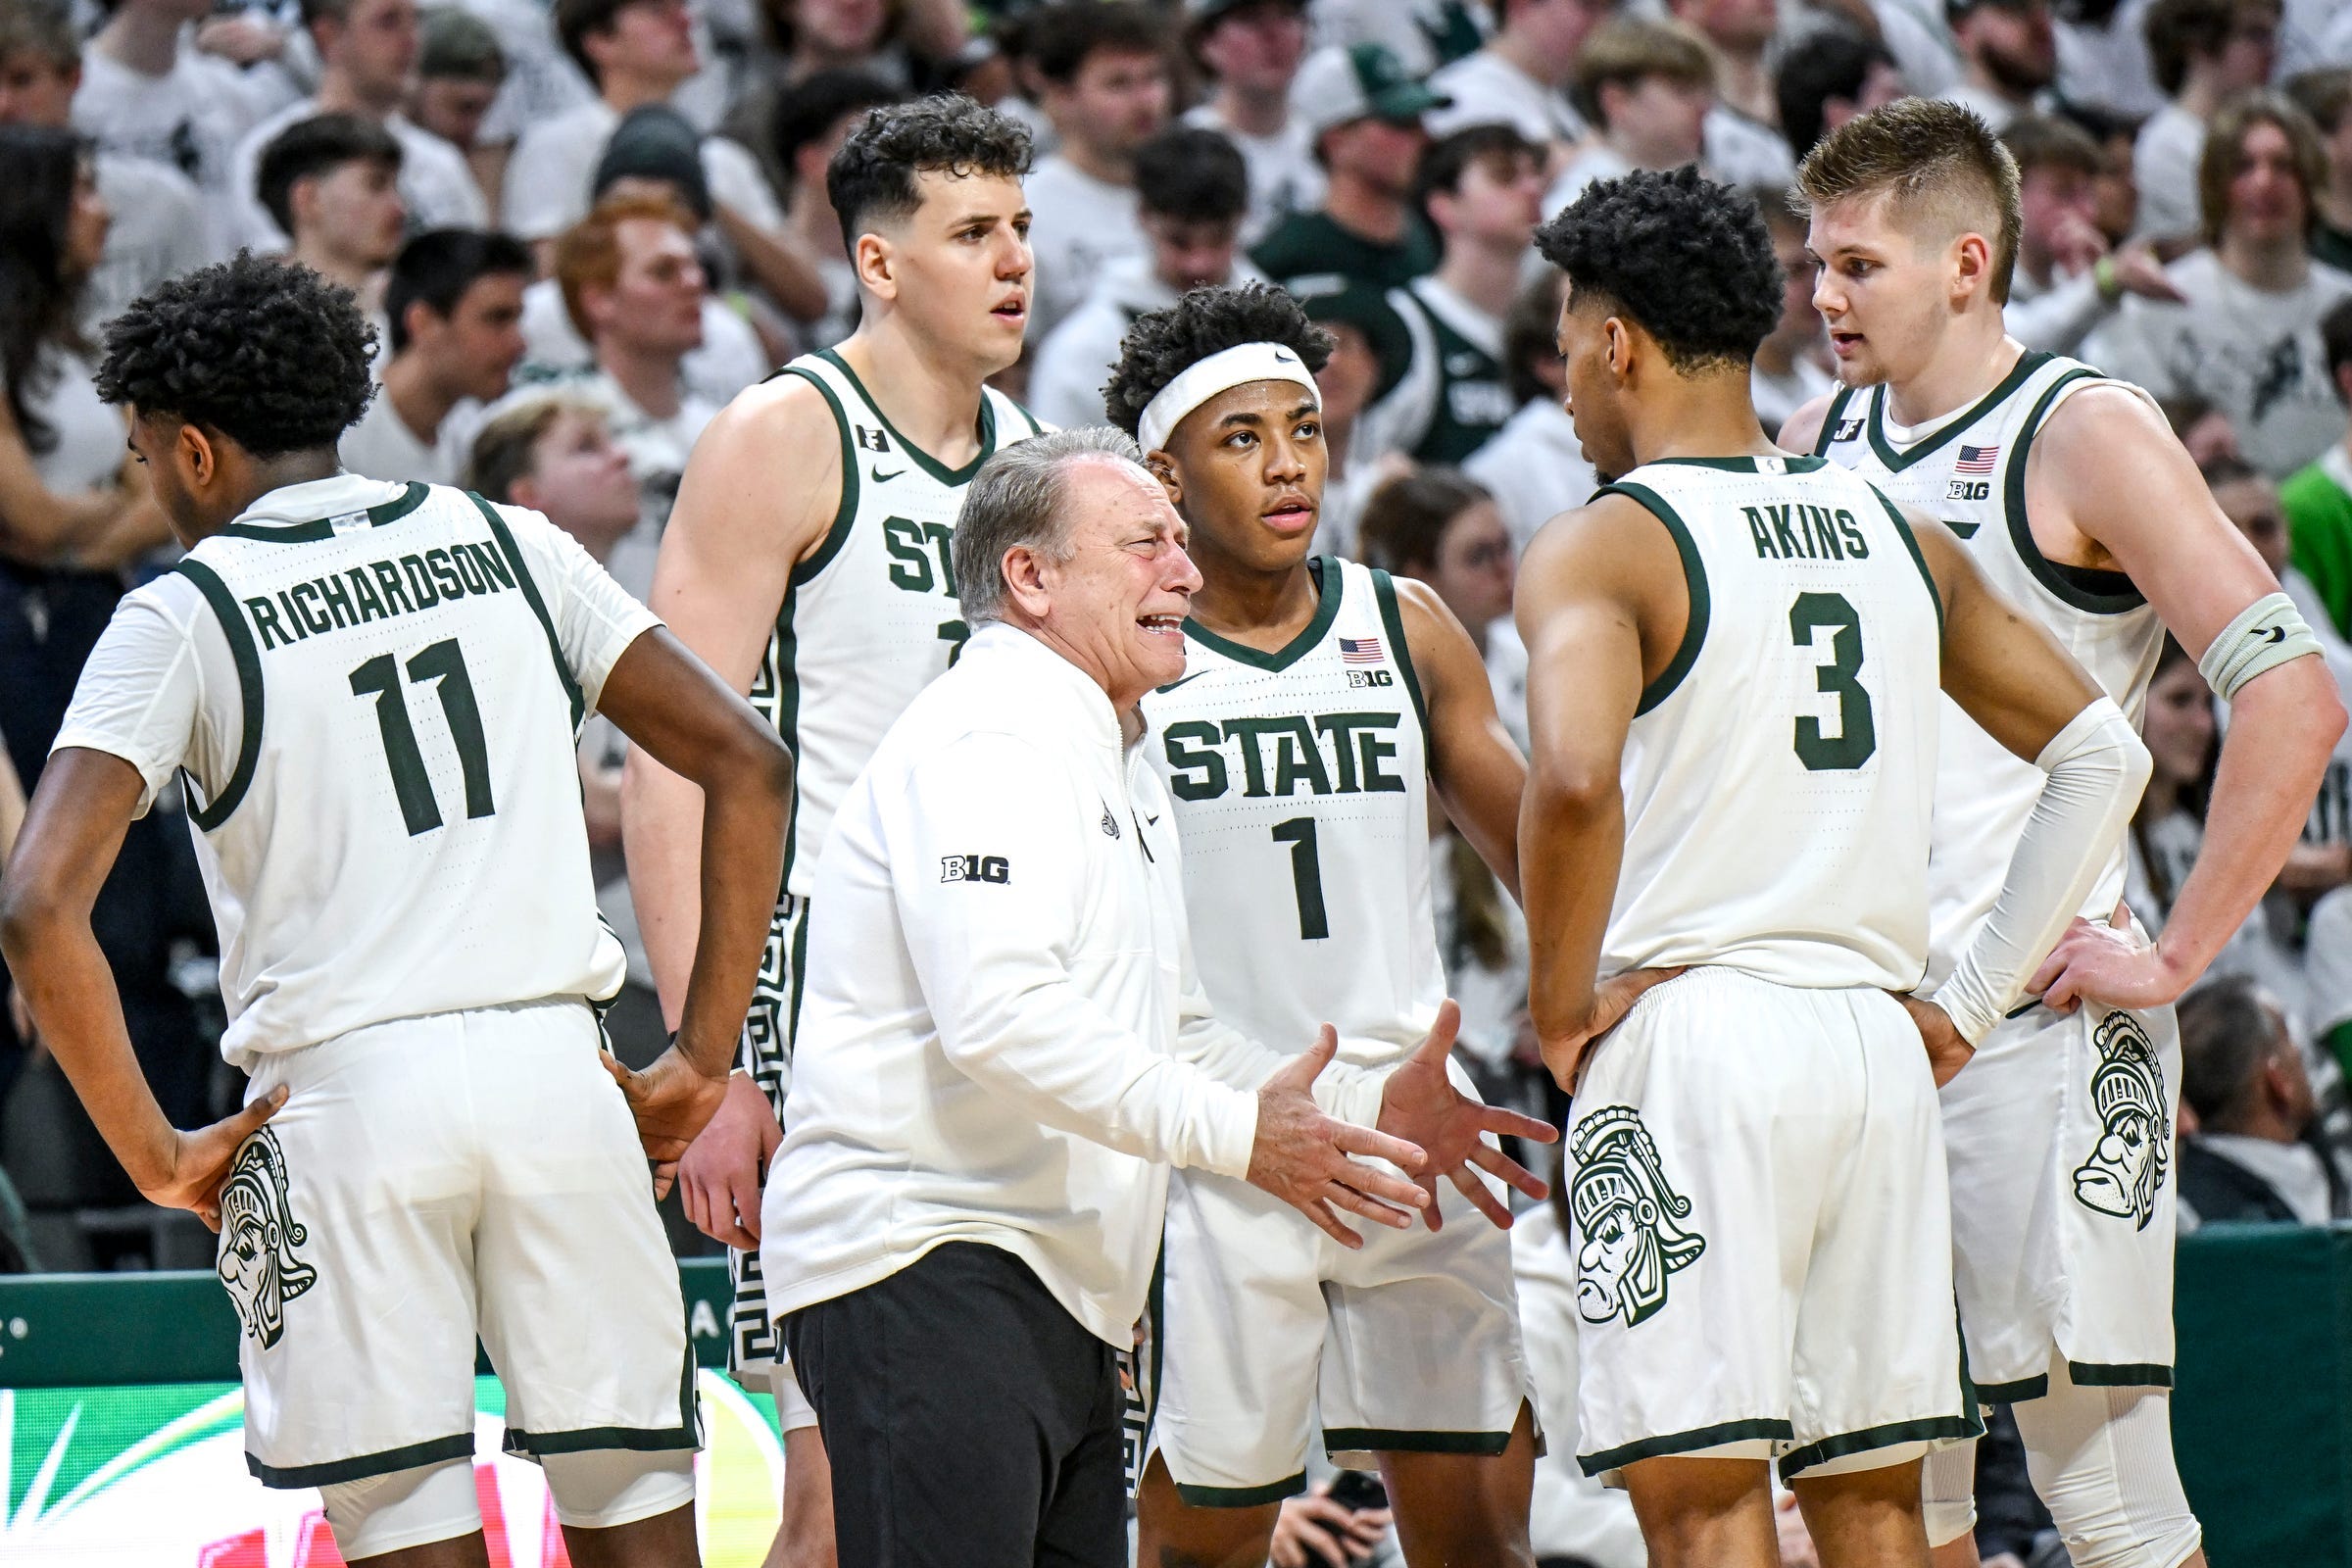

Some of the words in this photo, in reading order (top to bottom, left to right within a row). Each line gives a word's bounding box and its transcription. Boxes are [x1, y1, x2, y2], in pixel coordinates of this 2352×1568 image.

[1740, 504, 1870, 561] AKINS
[243, 540, 517, 652] RICHARDSON
[348, 637, 496, 837] 11
[1788, 591, 1877, 771] 3
[1162, 711, 1406, 802] STATE
[1271, 816, 1330, 940] 1
